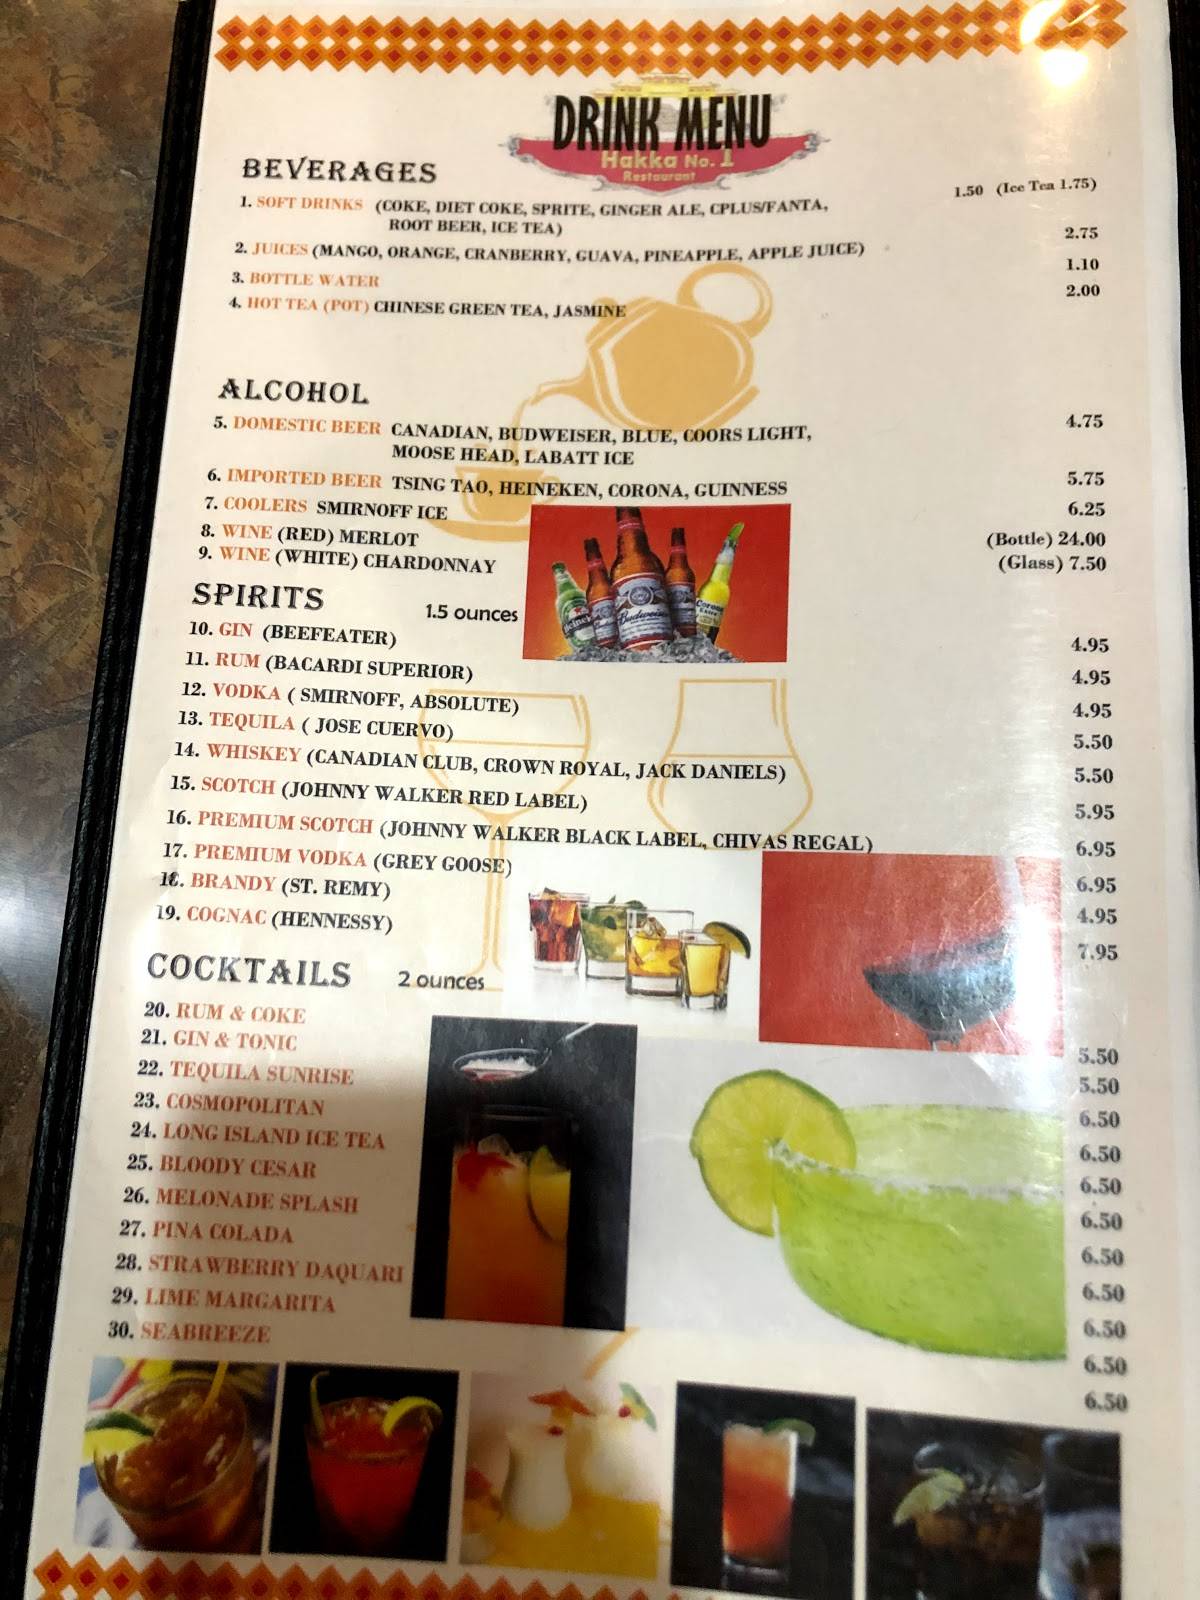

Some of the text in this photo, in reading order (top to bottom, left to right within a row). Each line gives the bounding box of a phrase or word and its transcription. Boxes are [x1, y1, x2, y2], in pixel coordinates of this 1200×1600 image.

[553, 94, 772, 150] DRINK MENU
[243, 156, 437, 183] BEVERAGES
[602, 151, 677, 168] Hakka
[685, 155, 714, 168] No.
[623, 171, 695, 182] Restaurant
[955, 177, 1096, 198] 1.50 (Ice Tea 1.75)
[257, 196, 828, 218] SOFT DRINKS (COKE, DIET COKE, SPRITE, GINGER ALE, CPLUS/FANTA,
[389, 219, 518, 235] ROOT BEER, ICE
[1065, 227, 1098, 239] 2.75
[252, 242, 865, 264] JUICES (MANGO, ORANGE, CRANBERRY, GUAVA, PINEAPPLE, APPLE JUICE)
[1067, 258, 1099, 271] 1.10
[250, 272, 379, 287] BOTTLE WATER
[1066, 284, 1100, 297] 2.00
[248, 297, 626, 319] HOT TEA (POT) CHINESE GREEN TEA, JASMINE
[218, 378, 369, 404] ALCOHOL
[234, 416, 811, 445] DOMESTIC BEER CANADIAN, BUDWEISER, BLUE, COORS LIGHT,
[1066, 414, 1103, 428] 4.75
[392, 445, 634, 465] MOOSE HEAD, LABATT ICE
[228, 469, 787, 500] IMPORTED BEER TSING TAO, HEINEKEN, CORONA, GUINNESS
[1067, 471, 1104, 486] 5.75
[224, 497, 413, 518] COOLERS SMIRNOFF
[1068, 501, 1105, 517] 6.25
[223, 524, 419, 547] WINE (RED) MERLOT
[987, 531, 1106, 550] (Bottle) 24.00
[220, 547, 496, 573] WINE (WHITE) CHARDONNAY
[999, 554, 1106, 574] (Glass) 7.50
[192, 583, 323, 610] SPIRITS
[426, 604, 518, 622] 1.5 ounces
[219, 623, 396, 649] GIN (BEEFEATER)
[1071, 637, 1109, 653] 4.95
[216, 653, 473, 684] RUM (BACARDI SUPERIOR)
[1072, 670, 1110, 685] 4.95
[214, 683, 519, 717] VODKA SMIRNOFF, ABSOLUTE)
[210, 712, 453, 743] TEQUILA JOSE CUERVO)
[208, 744, 786, 784] WHISKEY (CANADIAN CLUB, CROWN ROYAL, JACK DANIELS)
[202, 777, 587, 813] SCOTCH (JOHNNY WALKER RED LABEL)
[1075, 804, 1114, 820] 5.95
[198, 811, 873, 854] PREMIUM SCOTCH (JOHNNY WALKER BLACK LABEL, CHIVAS REGAL)
[194, 844, 512, 878] PREMIUM VODKA (GREY GOOSE)
[191, 873, 390, 902] BRANDY REMY)
[187, 906, 392, 935] COGNAC (HENNESSY)
[148, 953, 351, 988] COCKTAILS
[398, 971, 484, 991] 2 ounces
[176, 1002, 305, 1024] RUM COKE
[174, 1030, 297, 1051] GIN TONIC
[1078, 1048, 1119, 1065] 5.50
[170, 1060, 353, 1085] TEQUILA SUNRISE
[167, 1093, 324, 1116] COSMOPOLITAN
[1079, 1110, 1120, 1128] 6.50
[163, 1123, 384, 1150] LONG ISLAND ICE TEA
[159, 1155, 316, 1179] BLOODY CESAR
[156, 1188, 357, 1214] MELONADE SPLASH
[152, 1221, 293, 1243] PINA COLADA
[148, 1255, 403, 1284] STRAWBERRY DAQUARI
[144, 1288, 335, 1313] LIME MARGARITA
[141, 1322, 270, 1343] SEABREEZE
[1084, 1392, 1128, 1412] 6.50
